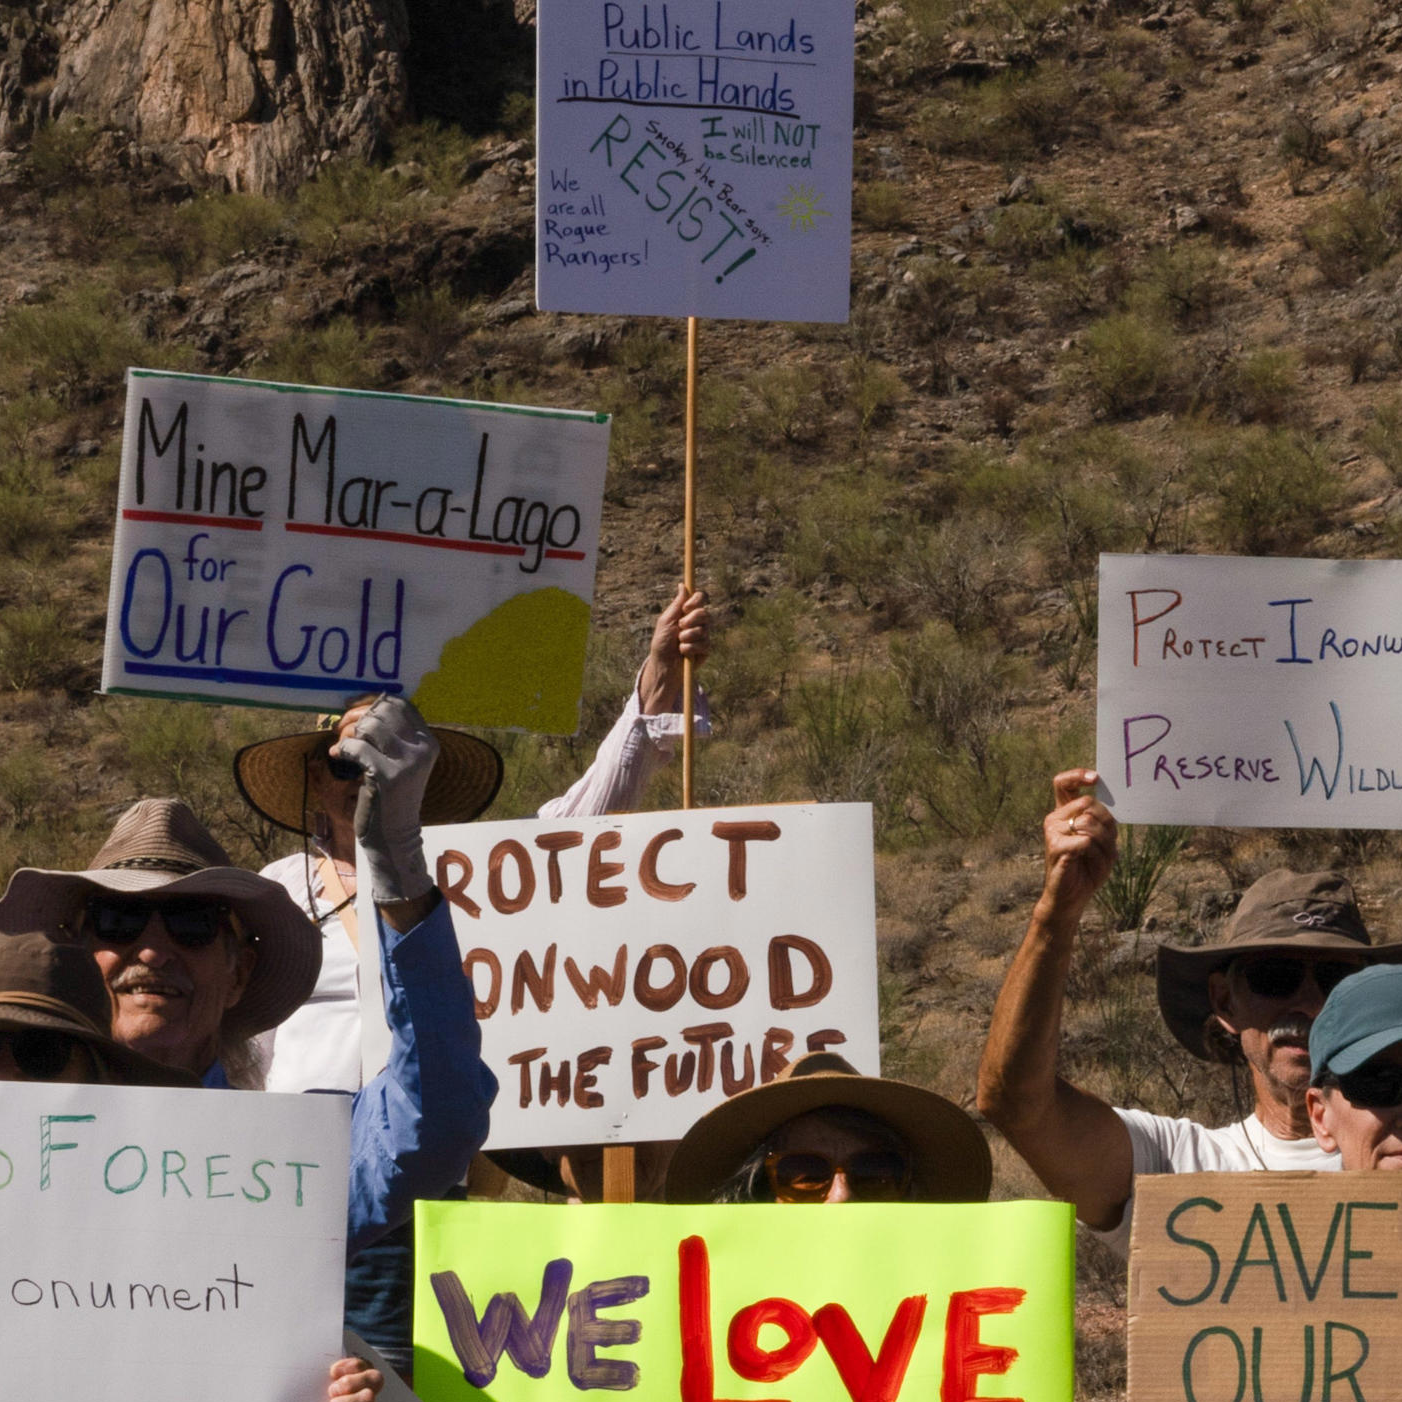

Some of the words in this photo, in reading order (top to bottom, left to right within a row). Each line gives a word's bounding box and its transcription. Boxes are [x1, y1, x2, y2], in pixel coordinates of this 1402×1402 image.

[604, 2, 700, 52] Public
[715, 1, 815, 54] Lands
[563, 72, 588, 98] in
[599, 58, 687, 100] Public
[698, 56, 795, 112] Hands
[700, 116, 727, 138] I
[733, 115, 765, 144] will
[774, 121, 821, 150] NOT
[704, 144, 726, 159] be
[730, 143, 812, 169] Silenced
[547, 202, 575, 215] are
[581, 194, 606, 217] all
[551, 167, 580, 192] We
[589, 113, 756, 284] RESIST!
[716, 182, 748, 215] Bear
[544, 219, 611, 245] Rogue
[136, 397, 266, 518] Mine
[287, 413, 581, 573] Mar-a-Lago
[185, 533, 236, 583] for
[120, 548, 249, 666] Our
[266, 564, 405, 680] Gold
[1126, 587, 1266, 667] PROTECT
[1123, 714, 1280, 790] PRESERVE
[436, 821, 782, 919] ROTECT
[462, 935, 834, 1021] ONWOOD
[507, 1046, 613, 1109] THE
[39, 1114, 320, 1207] FOREST
[1157, 1196, 1399, 1306] SAVE
[430, 1258, 650, 1390] WE
